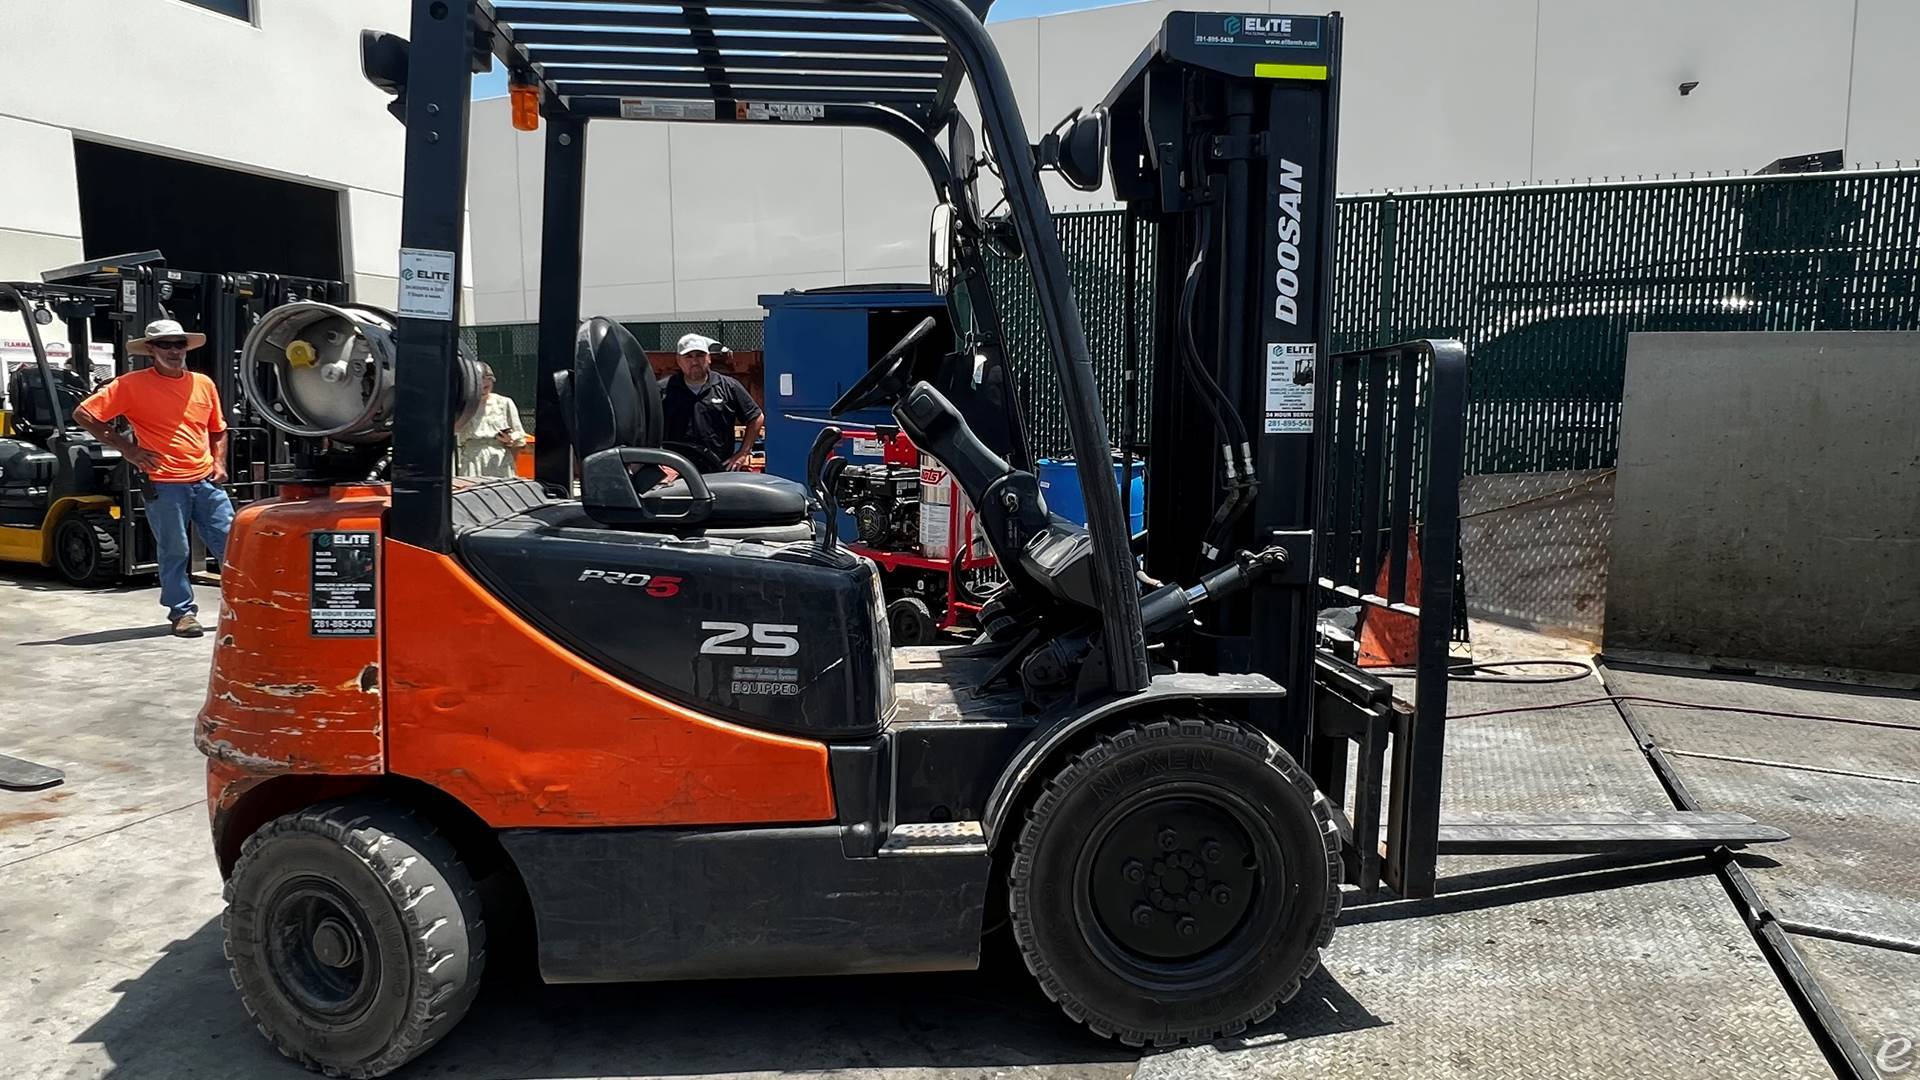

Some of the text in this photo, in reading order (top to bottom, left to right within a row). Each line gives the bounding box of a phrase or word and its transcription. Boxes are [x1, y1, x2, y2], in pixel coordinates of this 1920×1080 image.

[1245, 17, 1292, 32] ELITE
[1275, 158, 1303, 326] DOOSAN
[417, 270, 450, 281] ELITE
[1286, 346, 1314, 354] ELITE
[333, 534, 370, 544] ELITE
[314, 620, 373, 628] 281-895-5438
[700, 621, 800, 657] 25
[731, 681, 800, 695] EQUIPPED
